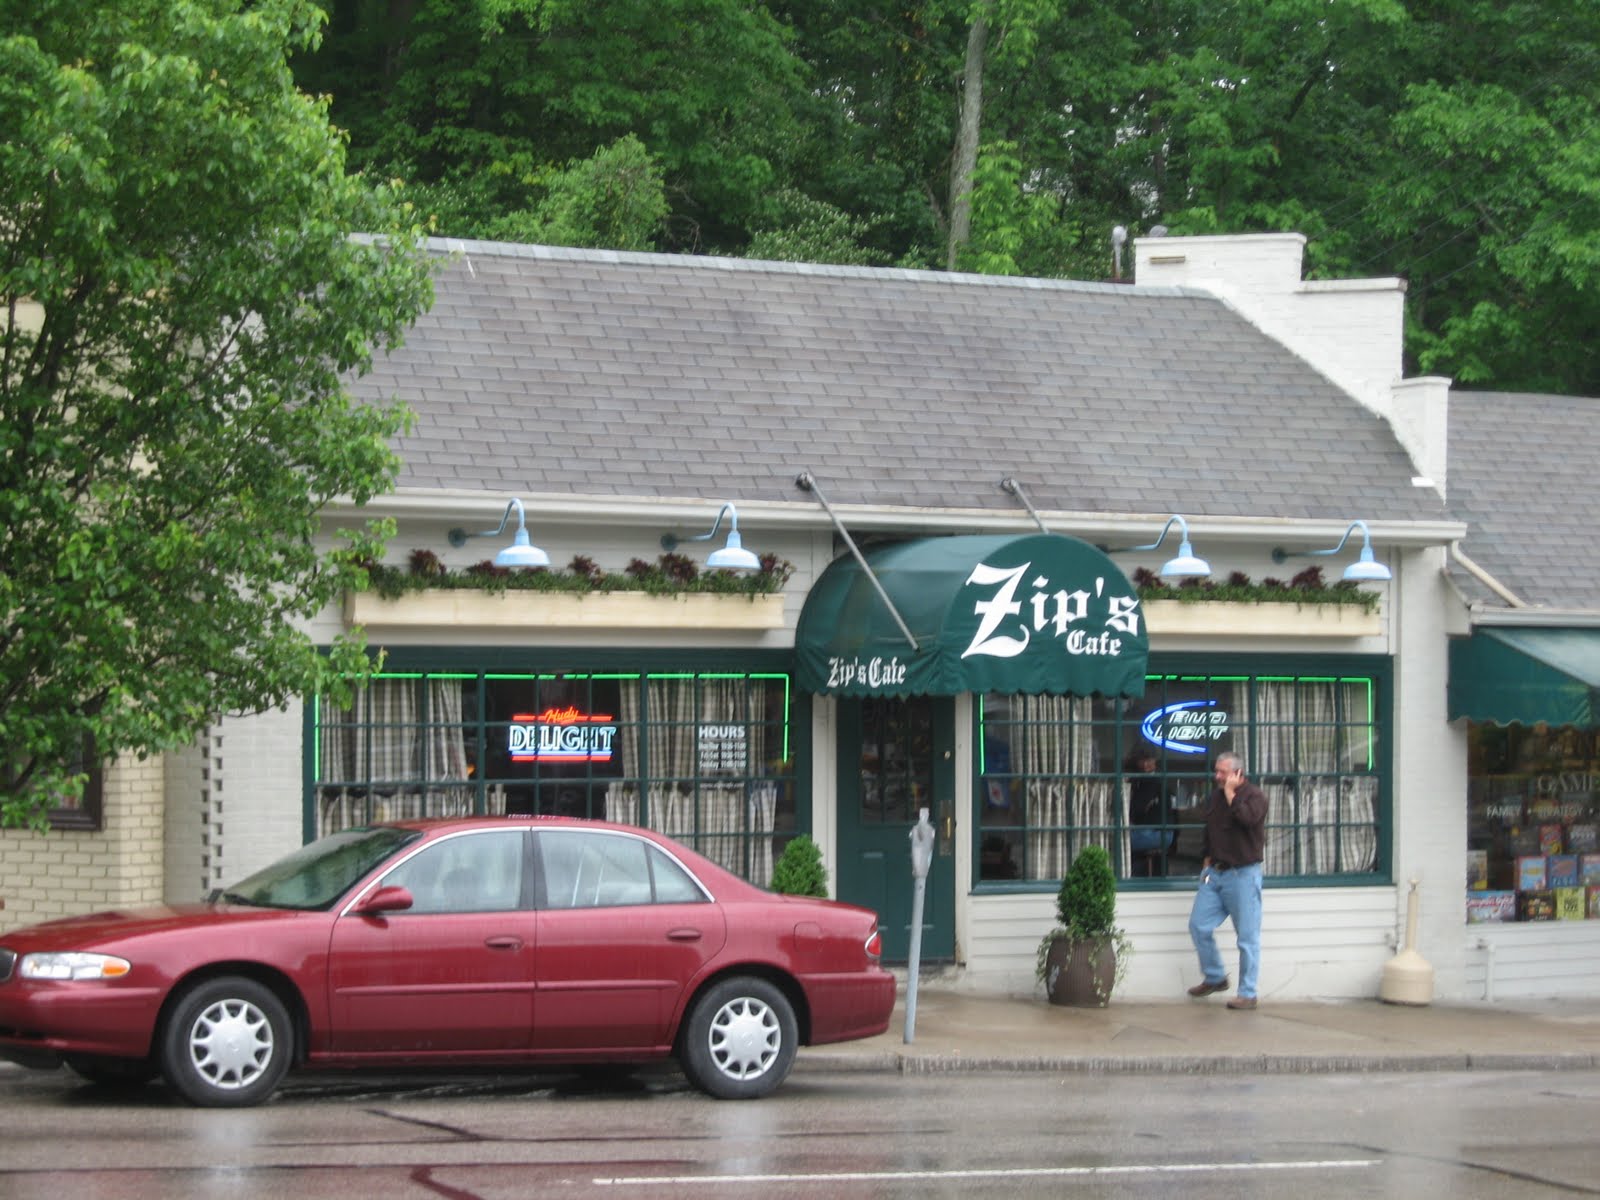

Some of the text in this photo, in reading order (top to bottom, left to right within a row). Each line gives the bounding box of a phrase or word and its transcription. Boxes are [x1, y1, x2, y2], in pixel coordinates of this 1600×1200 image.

[961, 561, 1140, 660] Zip's
[1066, 629, 1121, 656] Cafe
[826, 656, 907, 688] Zip's Cafe
[544, 706, 579, 724] Hudy
[699, 725, 746, 739] HOURS
